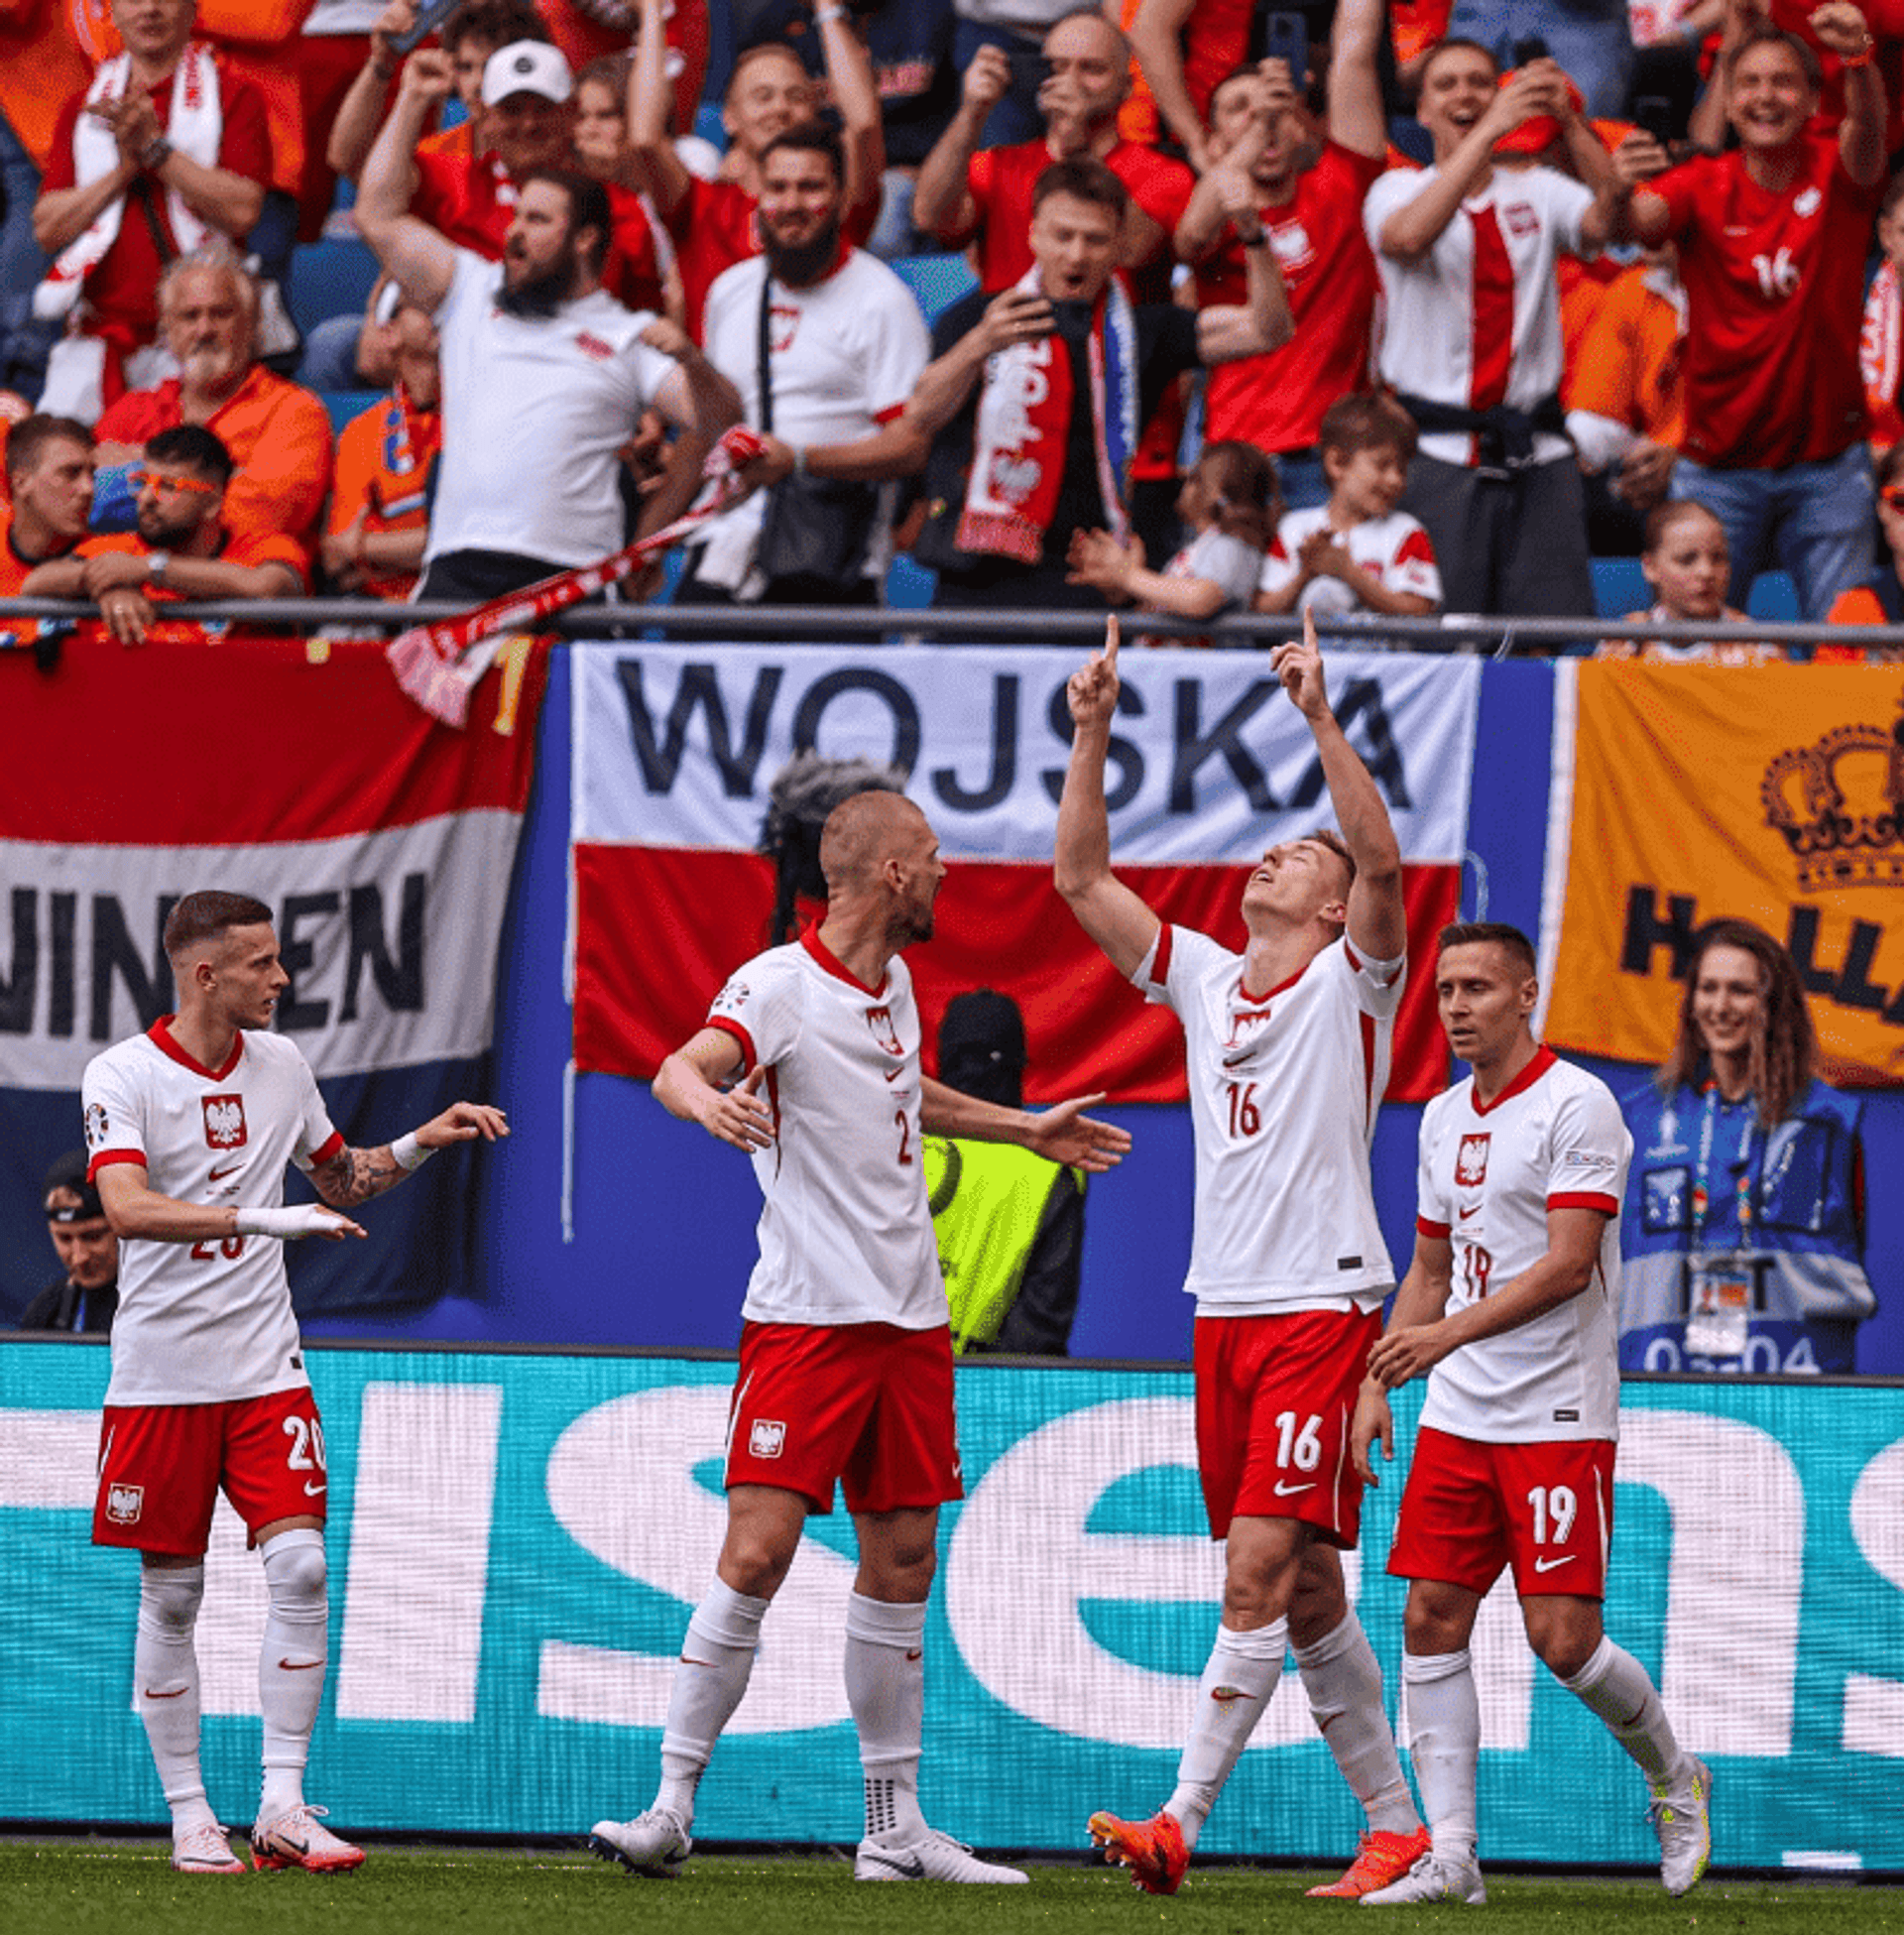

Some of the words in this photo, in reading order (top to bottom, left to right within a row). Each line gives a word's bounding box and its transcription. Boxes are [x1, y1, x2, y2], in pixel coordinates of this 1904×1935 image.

[615, 657, 1411, 814] WOJSKA
[1620, 880, 1904, 1026] HLL
[894, 1108, 912, 1165] 2
[1226, 1081, 1261, 1139] 16
[1464, 1243, 1491, 1299] 19
[1274, 1410, 1324, 1472] 16
[1527, 1485, 1577, 1544] 19
